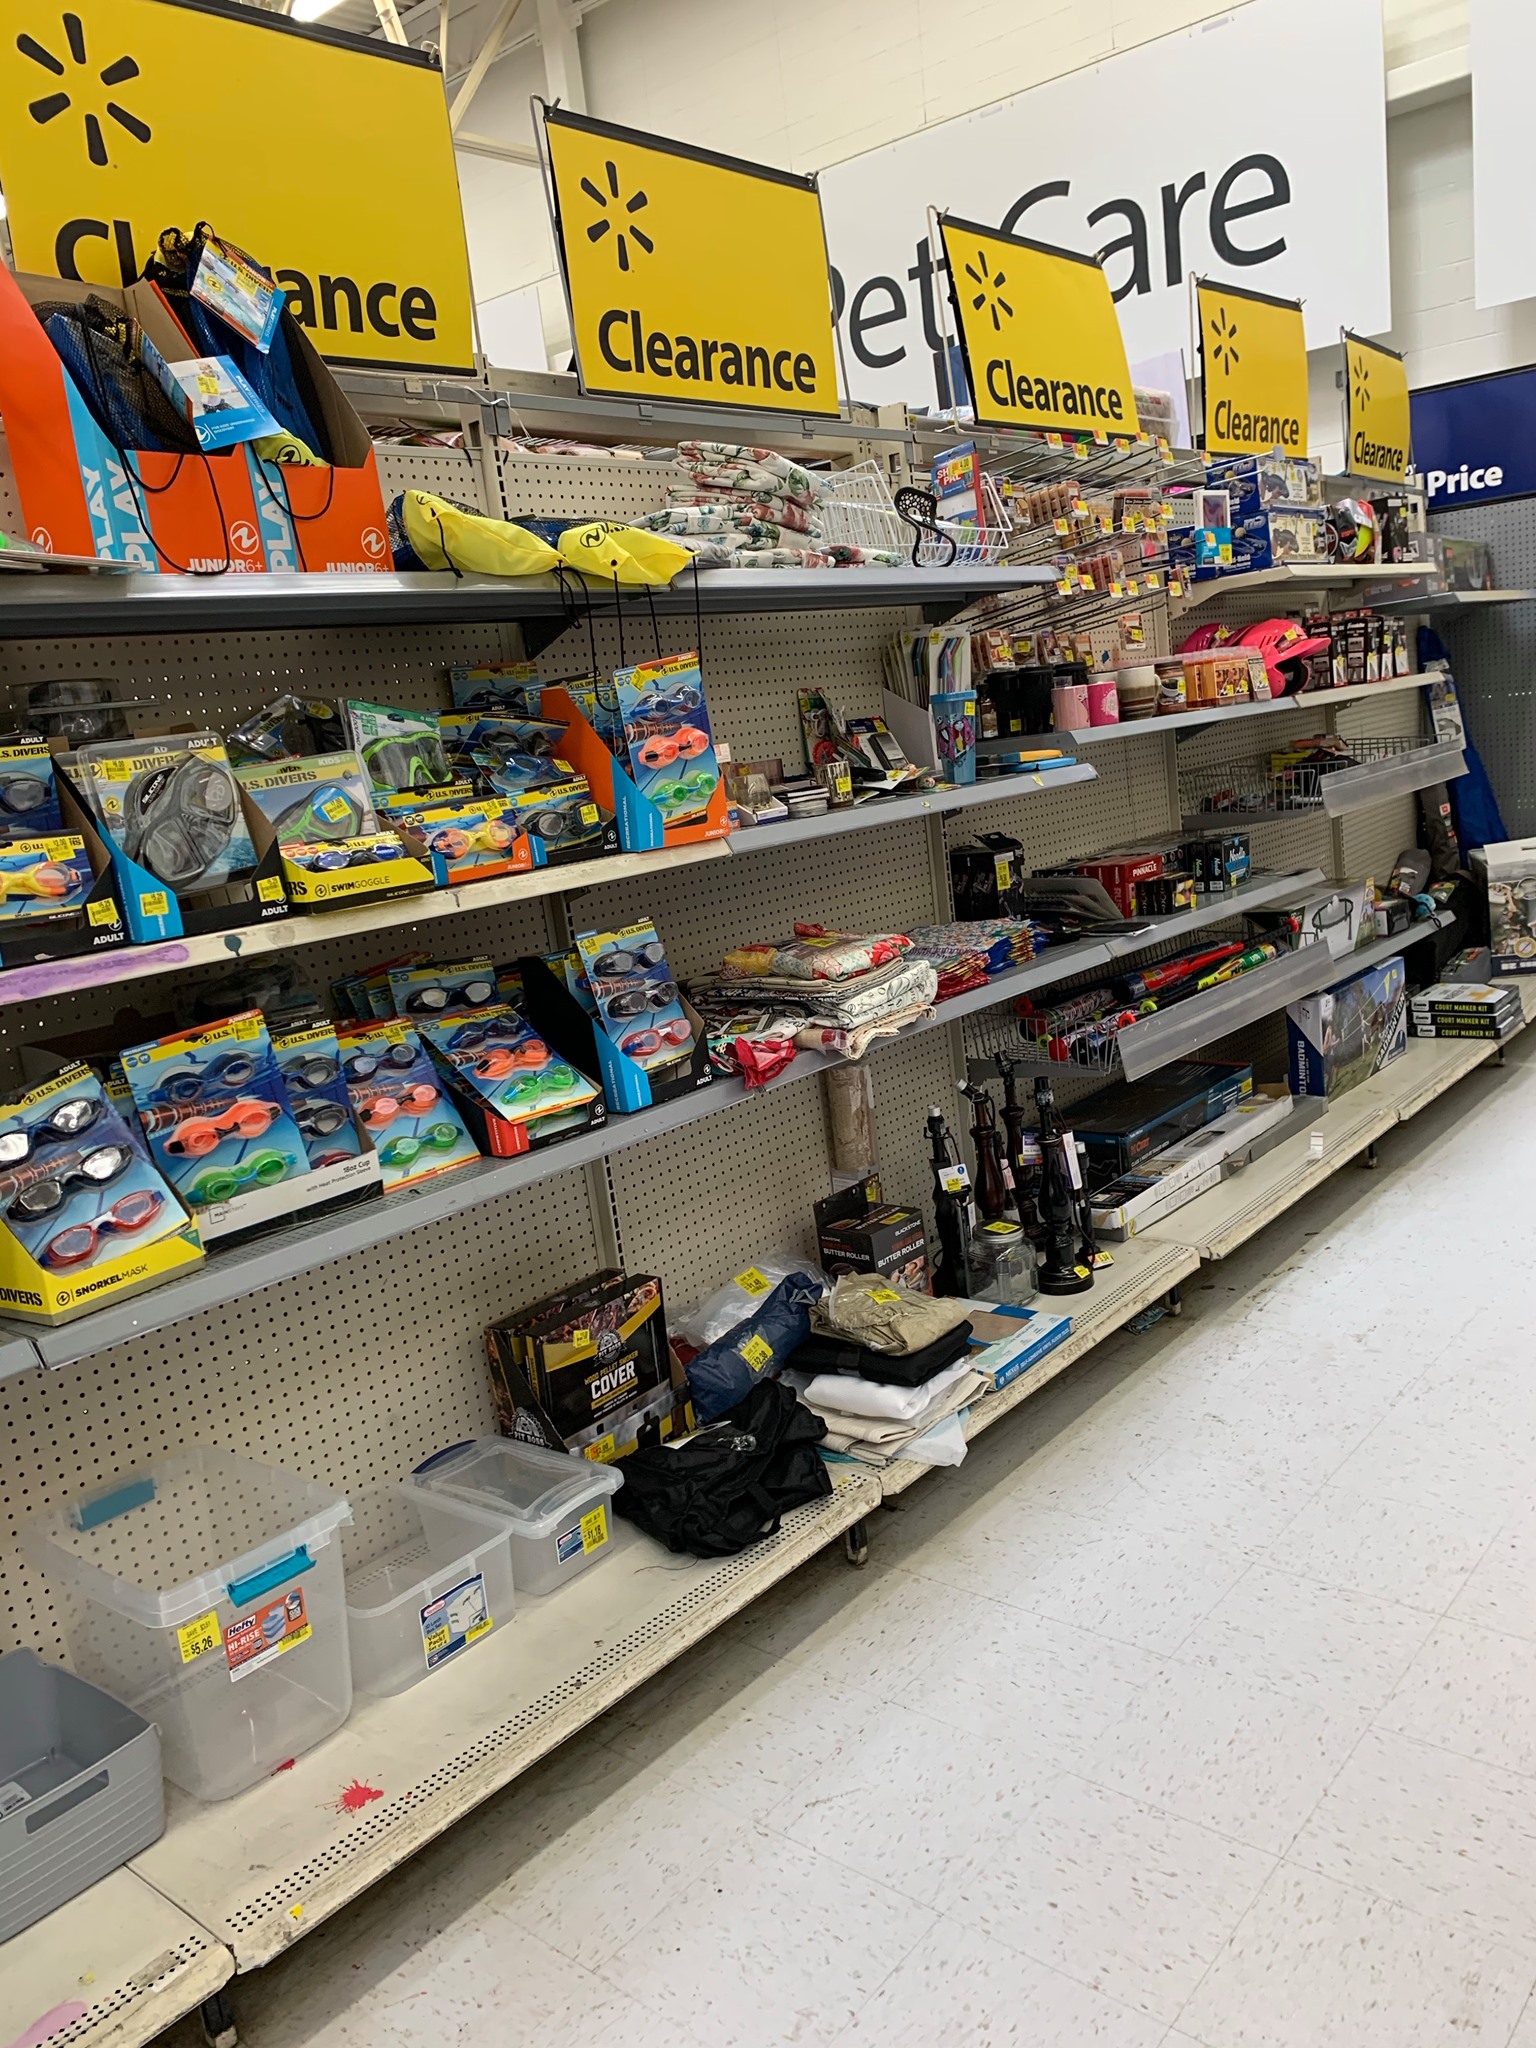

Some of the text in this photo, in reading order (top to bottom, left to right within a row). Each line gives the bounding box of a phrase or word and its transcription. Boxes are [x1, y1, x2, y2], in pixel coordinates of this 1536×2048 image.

[55, 218, 437, 341] Clance
[598, 309, 816, 394] Clearance
[986, 359, 1124, 420] Clearance
[1214, 400, 1299, 445] Clearance
[1354, 431, 1403, 472] Clearance
[1427, 464, 1503, 497] Price
[105, 458, 155, 573] PLAY
[254, 472, 296, 572] PLAY
[20, 736, 44, 745] ADULT
[13, 745, 50, 757] DIVERS
[132, 755, 181, 771] DIVER
[264, 771, 318, 788] DIVERS
[557, 787, 569, 795] U.S.
[1132, 862, 1158, 878] PINNACLE
[331, 875, 391, 893] SWIMGOGGLE
[261, 905, 289, 917] ADULT
[93, 932, 125, 945] ADULT
[1454, 1004, 1477, 1012] MARKER
[312, 1019, 331, 1029] ADULT
[1456, 1017, 1479, 1025] MARKER
[290, 1035, 306, 1044] U.S.
[306, 1027, 335, 1039] DIVERS
[1441, 1029, 1459, 1037] COURT
[58, 1060, 82, 1076] ADULT
[1297, 1040, 1307, 1094] BADMINTO
[36, 1066, 91, 1099] U.S. DIVERS
[696, 1075, 713, 1086] ADULT
[590, 1116, 606, 1126] ADULT
[358, 1159, 371, 1170] Cup
[894, 1218, 922, 1237] BLACKSTONE
[823, 1247, 870, 1261] BUTTER ROLLER
[877, 1249, 901, 1268] BUTTER
[901, 1238, 925, 1255] ROLLER
[75, 1264, 149, 1298] SNORKELMASK
[0, 1287, 43, 1307] DIVERS
[1005, 1363, 1020, 1378] NEXUS
[591, 1360, 636, 1400] COVER
[514, 1431, 545, 1446] PIT BOSS
[228, 1617, 255, 1638] Hefty
[427, 1629, 445, 1641] Value
[190, 1635, 213, 1655] $5.26
[228, 1630, 261, 1652] HI-RISE
[428, 1635, 446, 1648] Pack!
